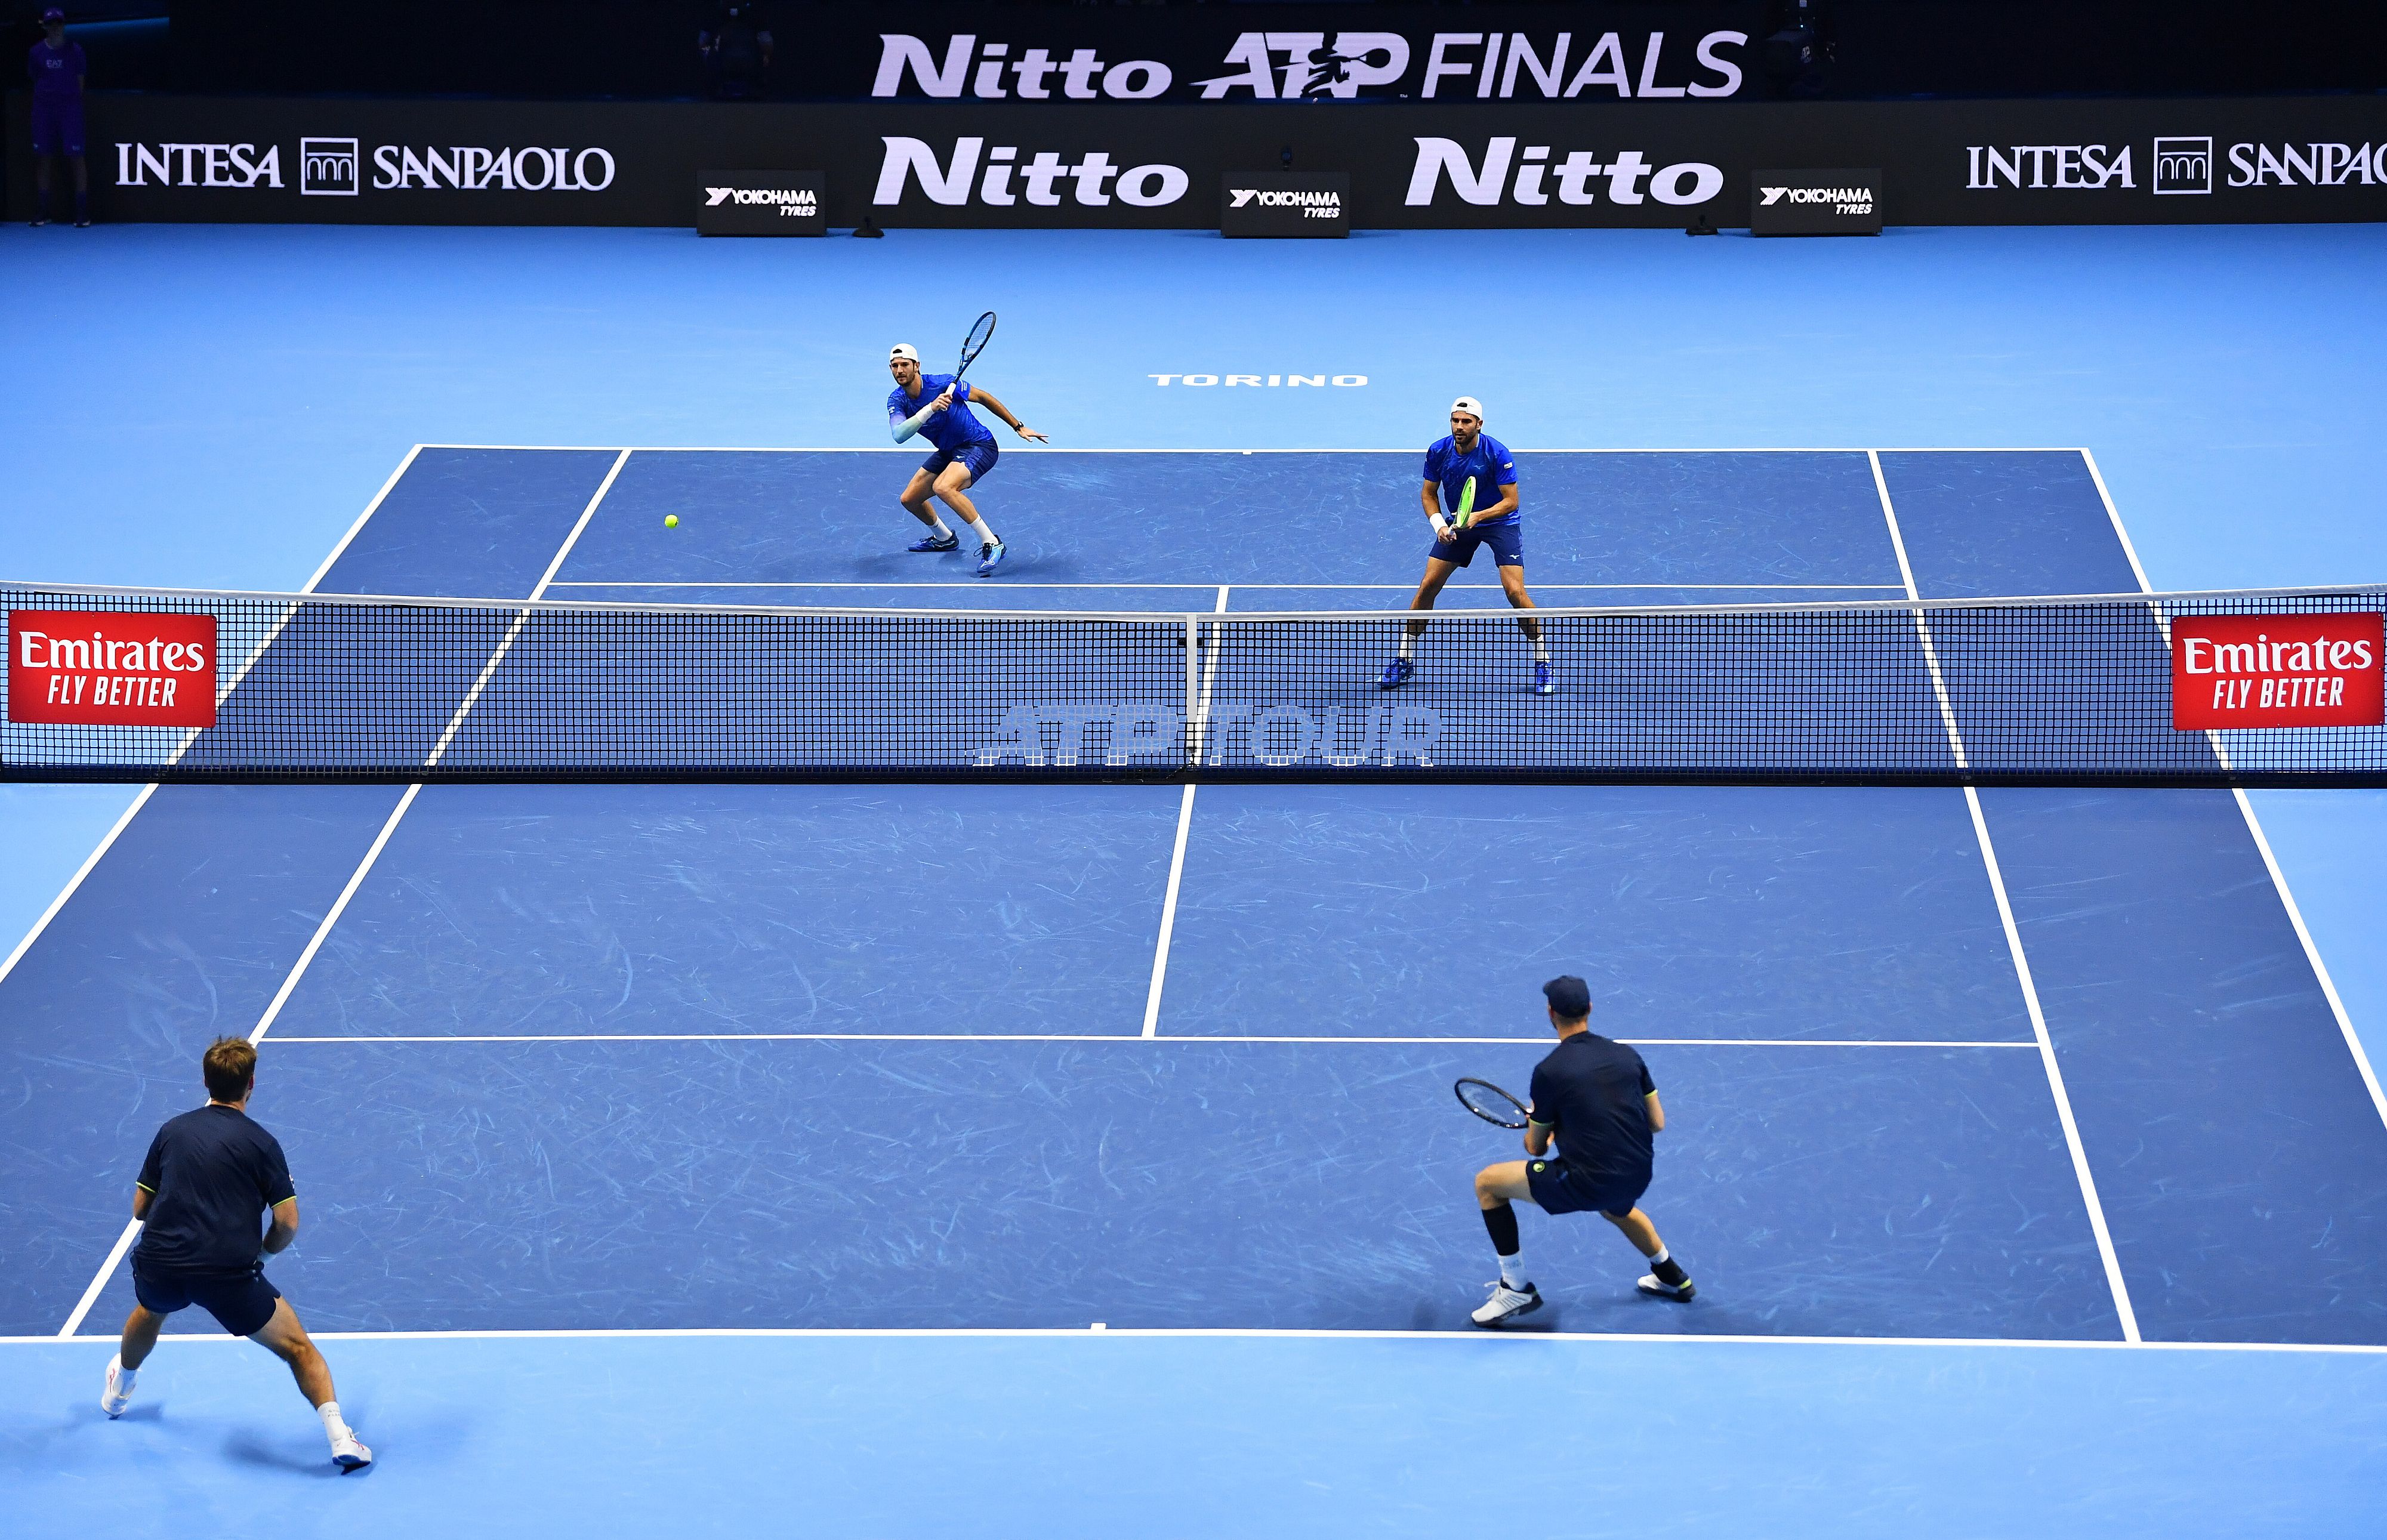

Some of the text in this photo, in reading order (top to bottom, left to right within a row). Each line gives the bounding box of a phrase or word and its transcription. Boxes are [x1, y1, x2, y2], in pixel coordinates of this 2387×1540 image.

[872, 31, 1748, 99] Nitto ATP FINALS
[116, 143, 615, 191] INTESA SANPAOLO
[872, 137, 1189, 206] Nitto
[1404, 137, 1724, 206] Nitto
[1966, 144, 2137, 189] INTESA
[732, 189, 817, 205] YOKOHAMA
[780, 205, 817, 217] TYRES
[1257, 190, 1341, 206] YOKOHAMA
[1787, 188, 1873, 204] YOKOHAMA
[1836, 204, 1873, 215] TYRES
[1304, 207, 1340, 218] TYRES
[1148, 374, 1368, 387] TORINO
[19, 631, 205, 672] Emirates
[2183, 634, 2372, 674] Emirates
[47, 675, 177, 707] FLY BETTER
[2213, 677, 2344, 709] FLY BETTER
[964, 705, 1442, 767] ATP TOUR
